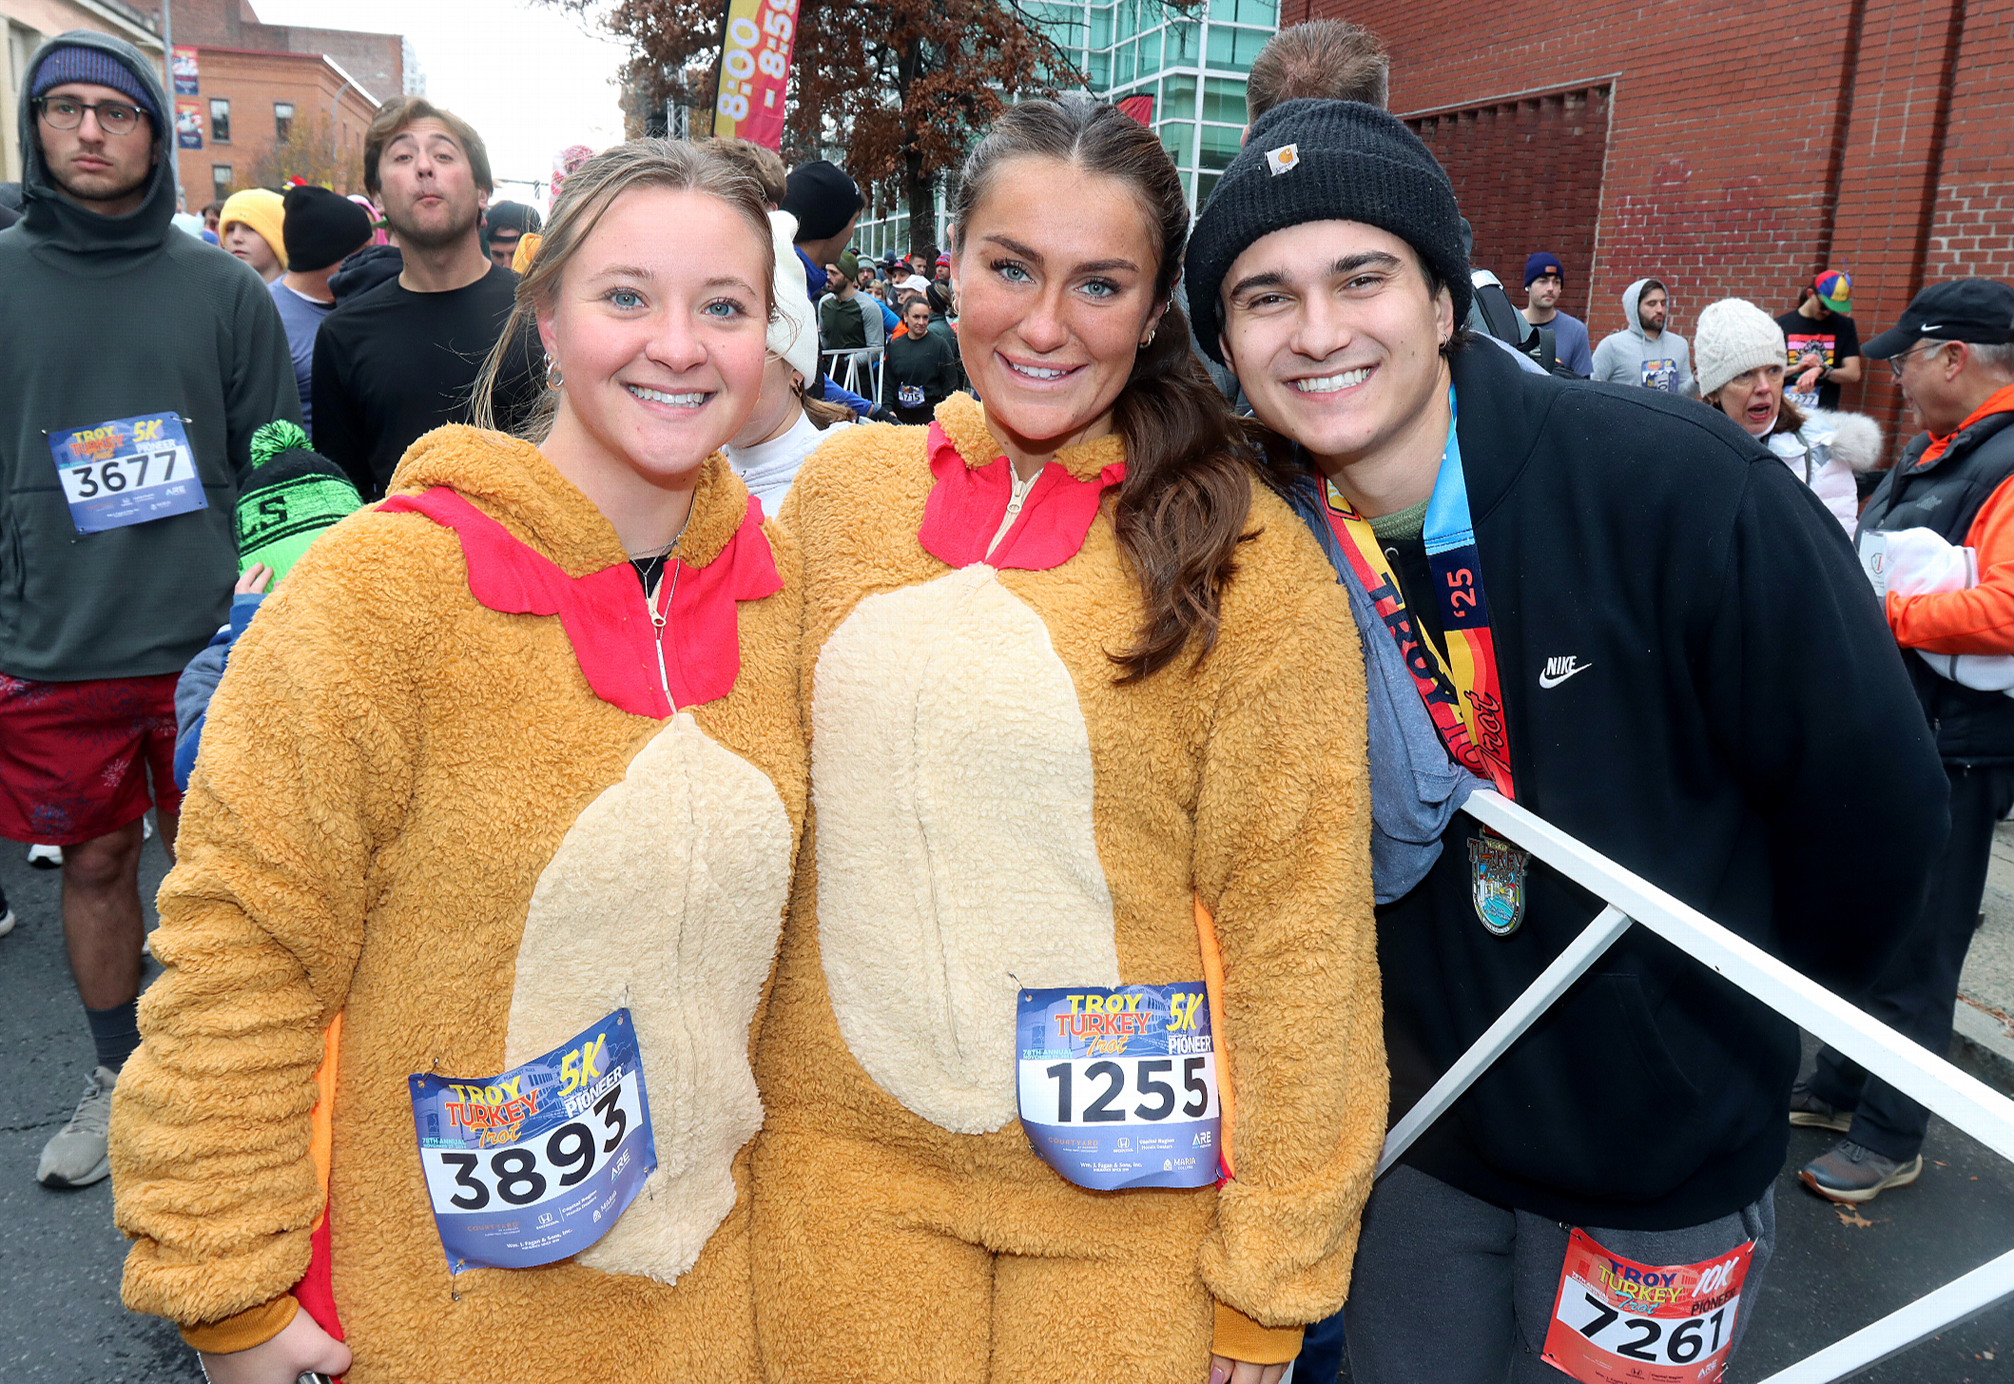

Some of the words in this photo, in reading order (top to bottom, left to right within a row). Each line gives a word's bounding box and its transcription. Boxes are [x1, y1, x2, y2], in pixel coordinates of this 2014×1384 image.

[717, 17, 760, 122] 8:00
[70, 434, 125, 456] TURKEY
[72, 426, 115, 443] TROY
[133, 419, 163, 442] 5K
[72, 450, 176, 497] 3677
[1546, 655, 1577, 675] NIKE
[1055, 1011, 1153, 1037] TURKEY
[1169, 1035, 1211, 1055] PIONEER
[1066, 994, 1143, 1014] TROY
[1166, 993, 1204, 1032] 5K
[1080, 1032, 1129, 1057] Trot
[448, 1075, 521, 1106] TROY
[557, 1033, 606, 1096] 5K
[1047, 1057, 1208, 1122] 1255
[445, 1088, 540, 1128] TURKEY
[564, 1065, 623, 1118] PIONEER
[441, 1084, 627, 1210] 3893
[470, 1121, 522, 1148] Trot
[1599, 1265, 1686, 1304] TURKEY
[1691, 1287, 1737, 1316] PIONEER
[1608, 1258, 1677, 1287] TROY
[1692, 1256, 1739, 1298] 10K
[1615, 1290, 1660, 1315] Trot
[1580, 1292, 1725, 1363] 7261
